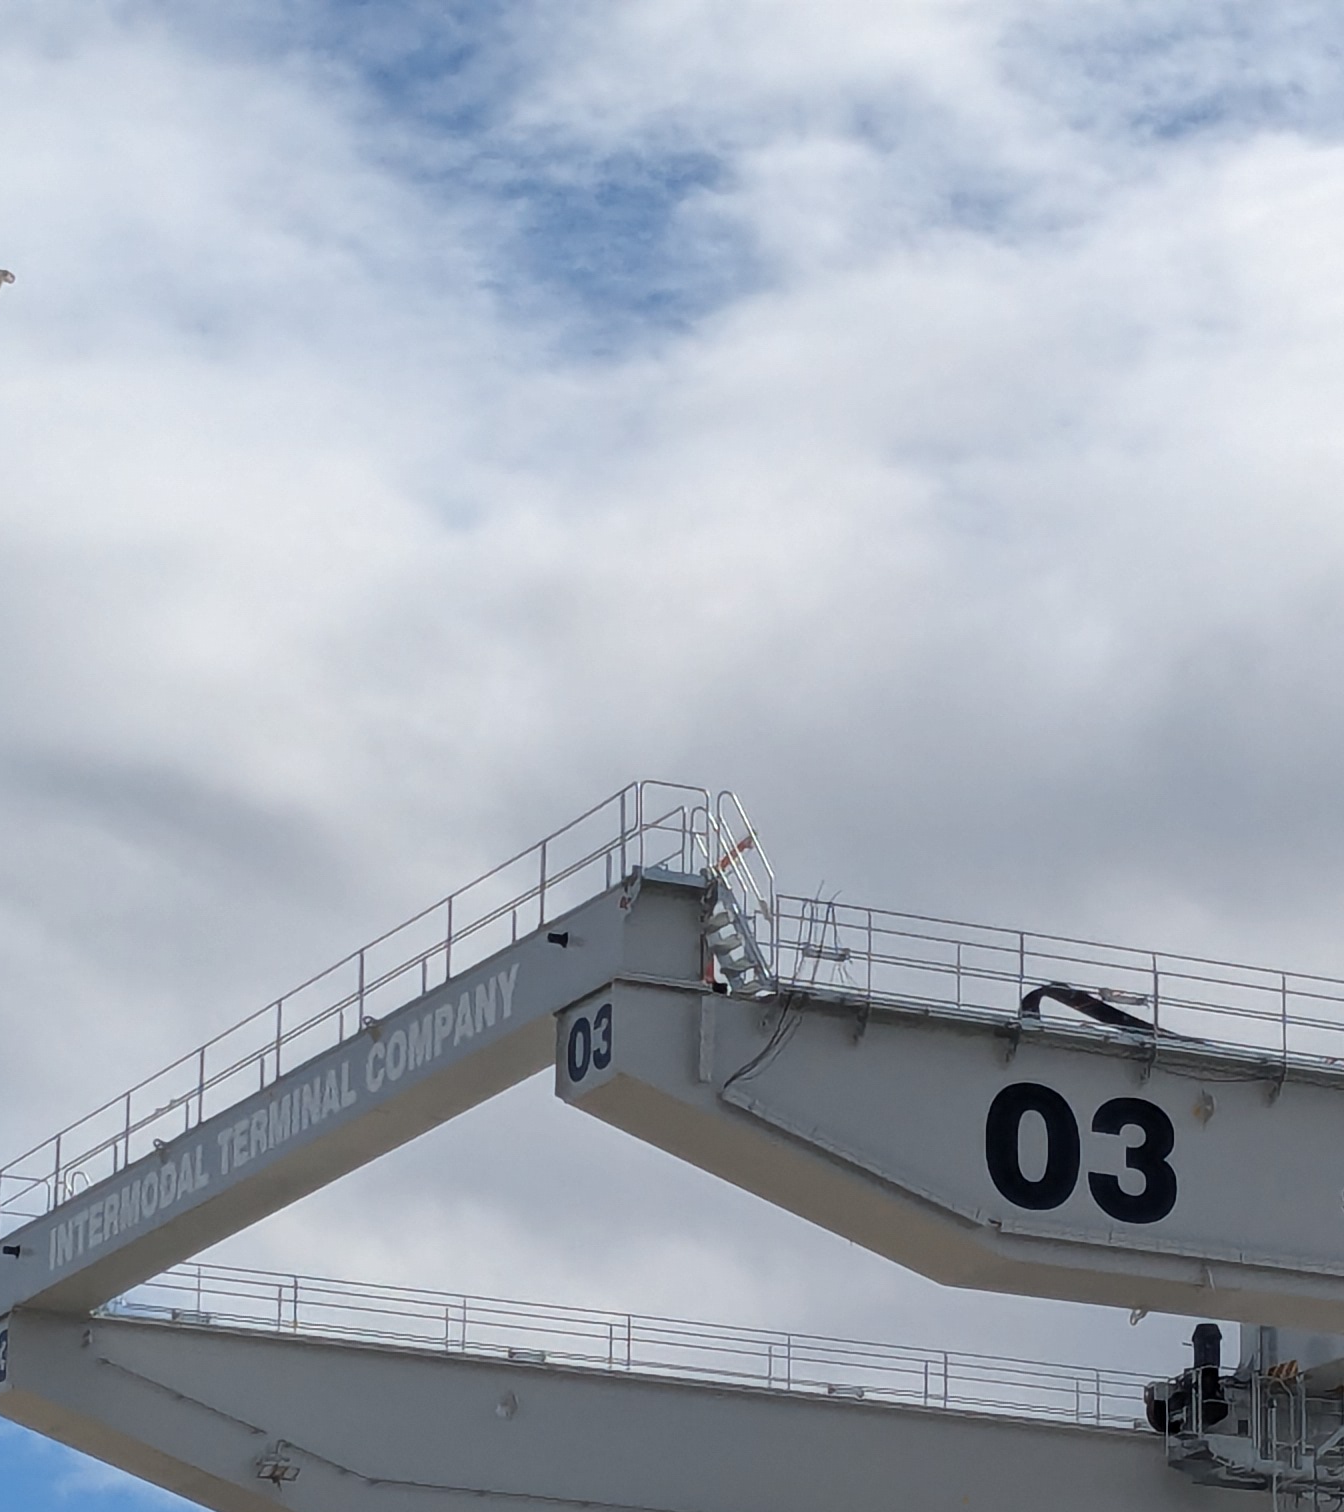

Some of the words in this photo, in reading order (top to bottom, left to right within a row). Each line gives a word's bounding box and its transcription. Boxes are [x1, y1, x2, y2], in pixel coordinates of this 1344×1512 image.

[567, 1003, 612, 1082] 03
[49, 1144, 209, 1270] INTERMODAL
[217, 1062, 356, 1175] TERMINAL
[365, 963, 519, 1092] COMPANY
[985, 1082, 1177, 1224] 03
